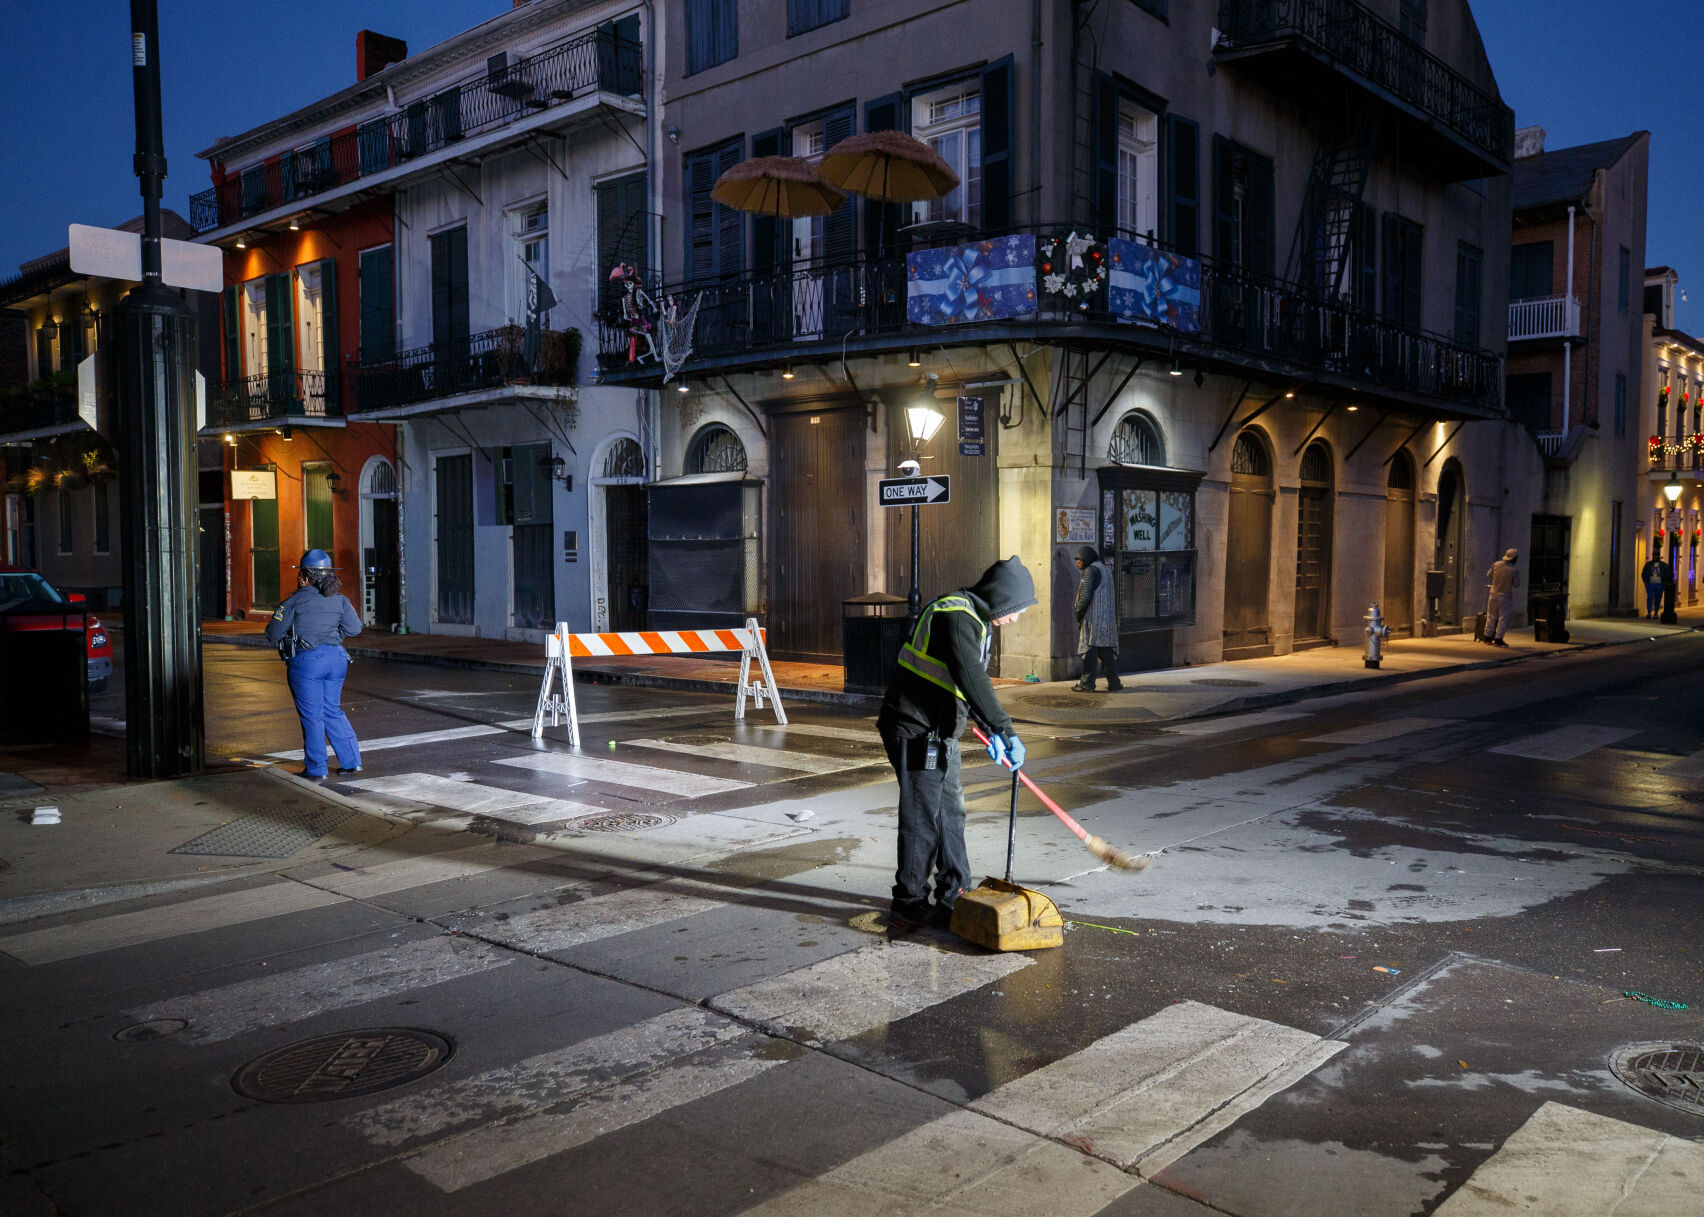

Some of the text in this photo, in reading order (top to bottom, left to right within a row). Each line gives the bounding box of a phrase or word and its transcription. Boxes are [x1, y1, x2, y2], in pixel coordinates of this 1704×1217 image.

[886, 485, 928, 498] ONE WAY
[1129, 512, 1156, 528] WASHING
[1133, 530, 1151, 541] WELL
